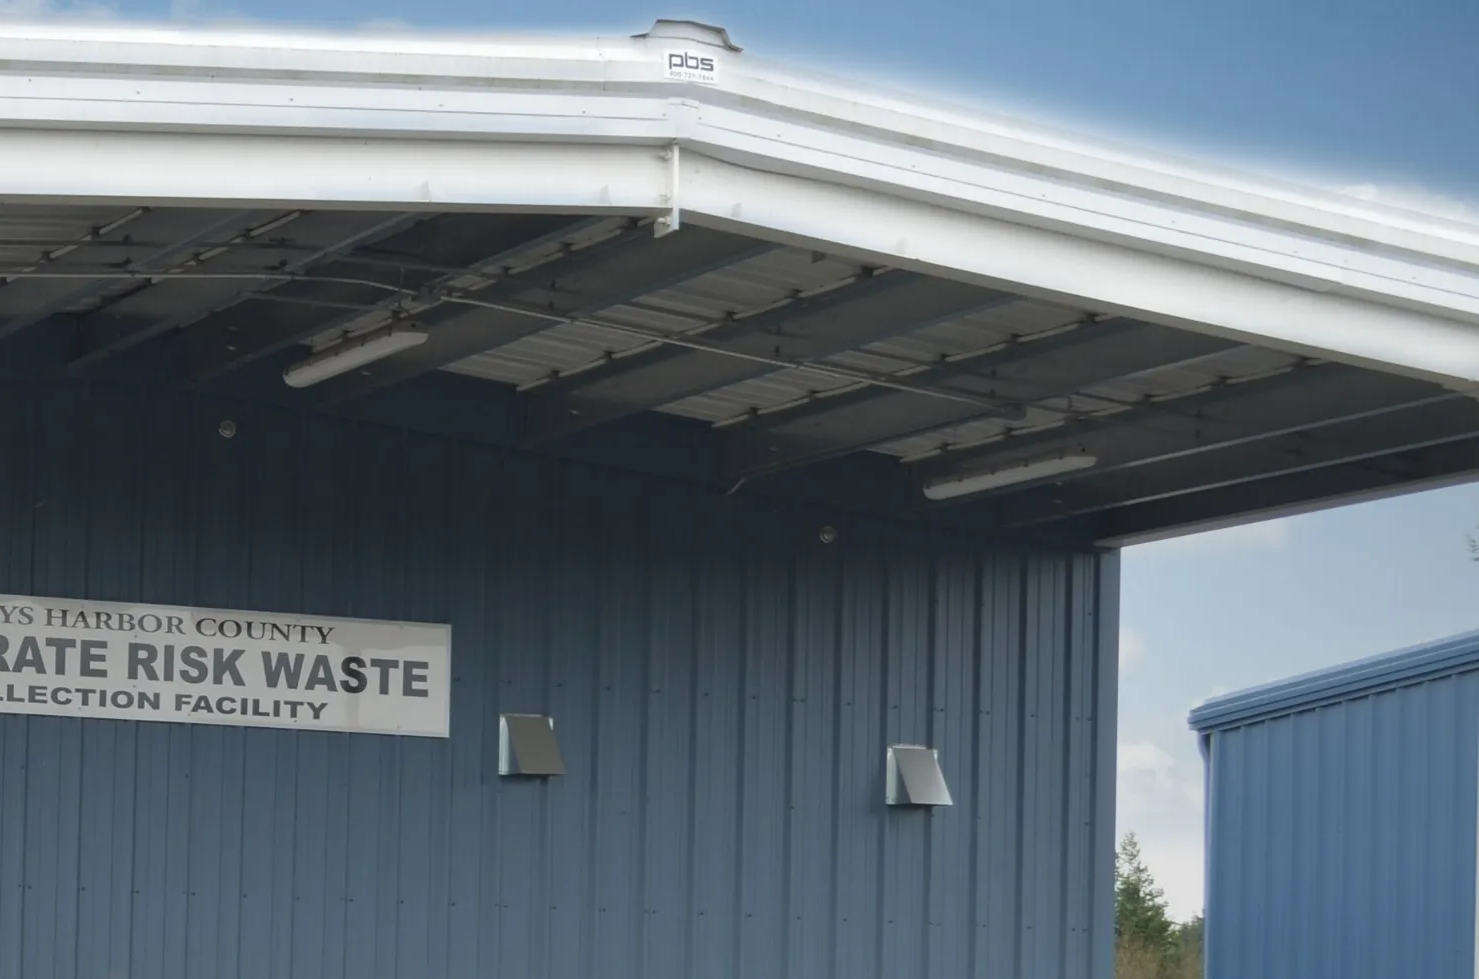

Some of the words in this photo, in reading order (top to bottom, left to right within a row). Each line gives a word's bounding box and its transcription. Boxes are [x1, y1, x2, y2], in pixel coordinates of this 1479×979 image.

[669, 52, 714, 71] pbs
[45, 608, 186, 637] HARBOR
[194, 618, 335, 645] COUNTY
[127, 642, 246, 686] RISK
[262, 651, 430, 697] WASTE
[174, 695, 329, 720] FACILITY
